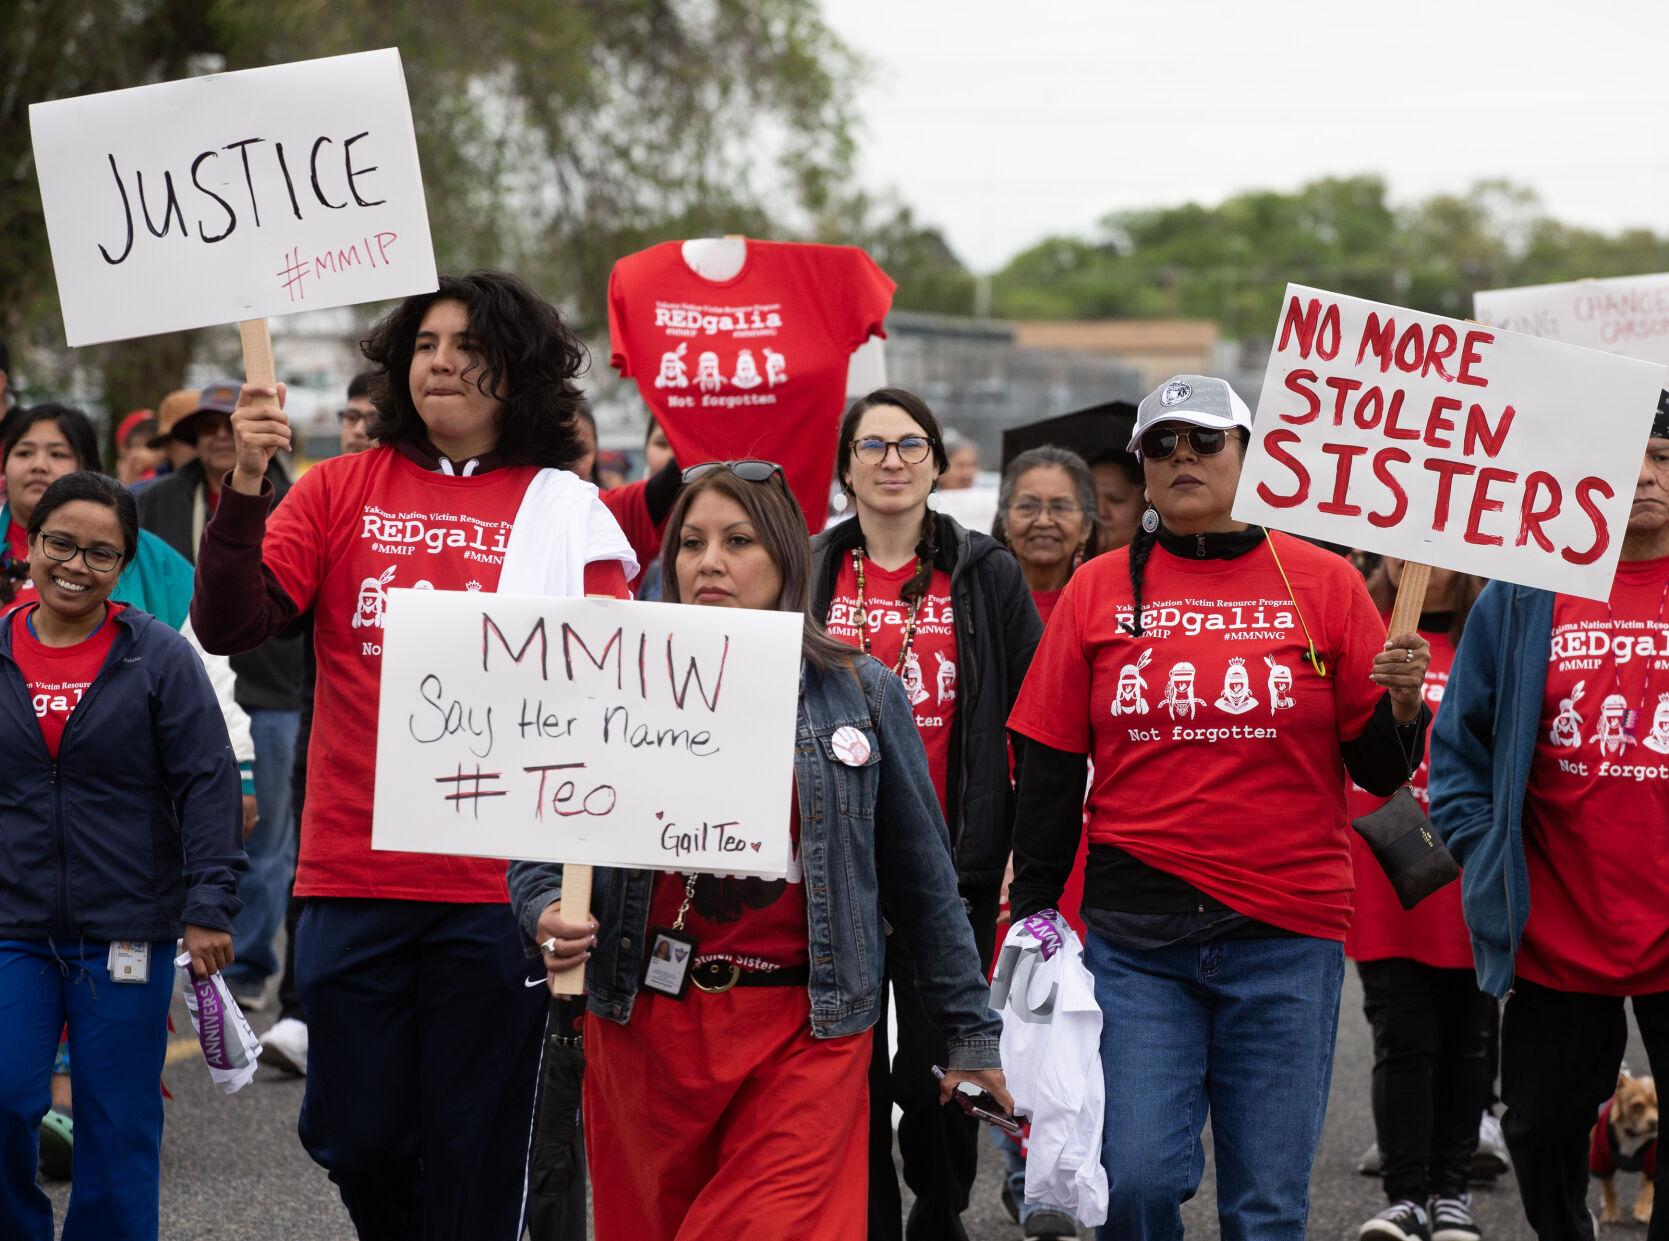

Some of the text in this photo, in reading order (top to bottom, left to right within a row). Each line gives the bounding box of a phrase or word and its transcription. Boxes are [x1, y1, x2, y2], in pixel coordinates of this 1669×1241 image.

[97, 131, 387, 265] JUSTICE
[276, 231, 398, 302] #MMIP
[655, 308, 783, 335] REDgalia
[1277, 295, 1343, 362] NO
[1355, 311, 1496, 388] MORE
[667, 394, 777, 408] Not forgotten
[1279, 368, 1516, 459] STOLEN
[1256, 428, 1615, 566] SISTERS
[364, 505, 396, 519] Yakama
[398, 512, 427, 521] Nation
[429, 513, 458, 522] Victim
[460, 514, 499, 529] Resource
[371, 542, 415, 556] #MMIP
[868, 597, 893, 607] Victim
[1152, 599, 1183, 608] Nation
[1184, 598, 1215, 608] Victim
[1216, 599, 1257, 608] Resource
[1258, 598, 1295, 608] Program
[1114, 606, 1295, 636] REDgalia
[1579, 620, 1612, 630] Nation
[1613, 620, 1645, 630] Victim
[827, 627, 858, 637] MMIP
[1223, 631, 1286, 641] #MMNWG
[482, 612, 729, 713] MMIW
[1558, 658, 1602, 672] #MMIP
[35, 681, 61, 691] Victim
[409, 673, 493, 758] Say
[518, 698, 579, 740] Her
[1128, 726, 1278, 742] Not forgotten
[1558, 758, 1588, 776] Not
[661, 821, 746, 858] Gail Teo
